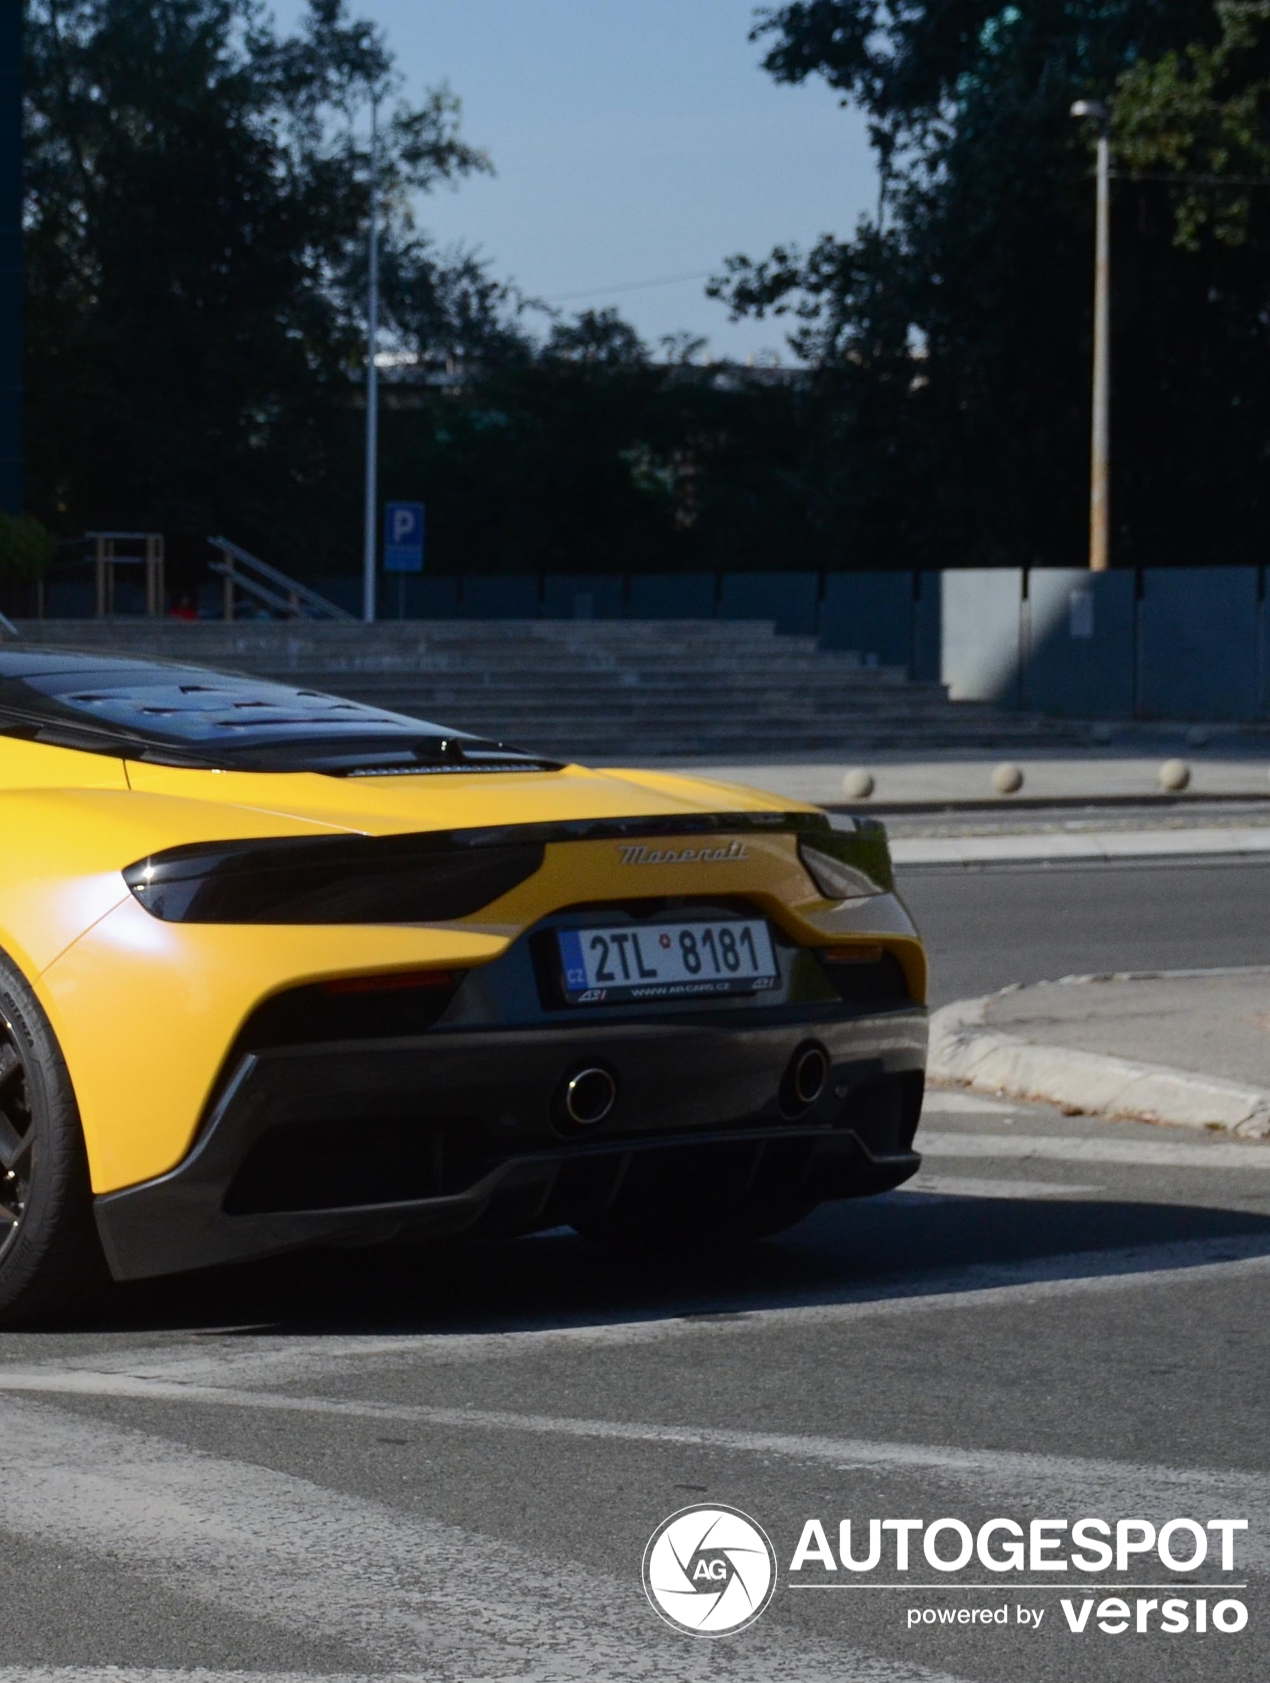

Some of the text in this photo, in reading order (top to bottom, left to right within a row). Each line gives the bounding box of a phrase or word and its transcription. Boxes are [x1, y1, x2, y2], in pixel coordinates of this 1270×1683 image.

[392, 509, 415, 542] P
[617, 841, 750, 865] Maserati
[590, 926, 759, 982] 2TL 8181
[567, 968, 585, 983] CZ
